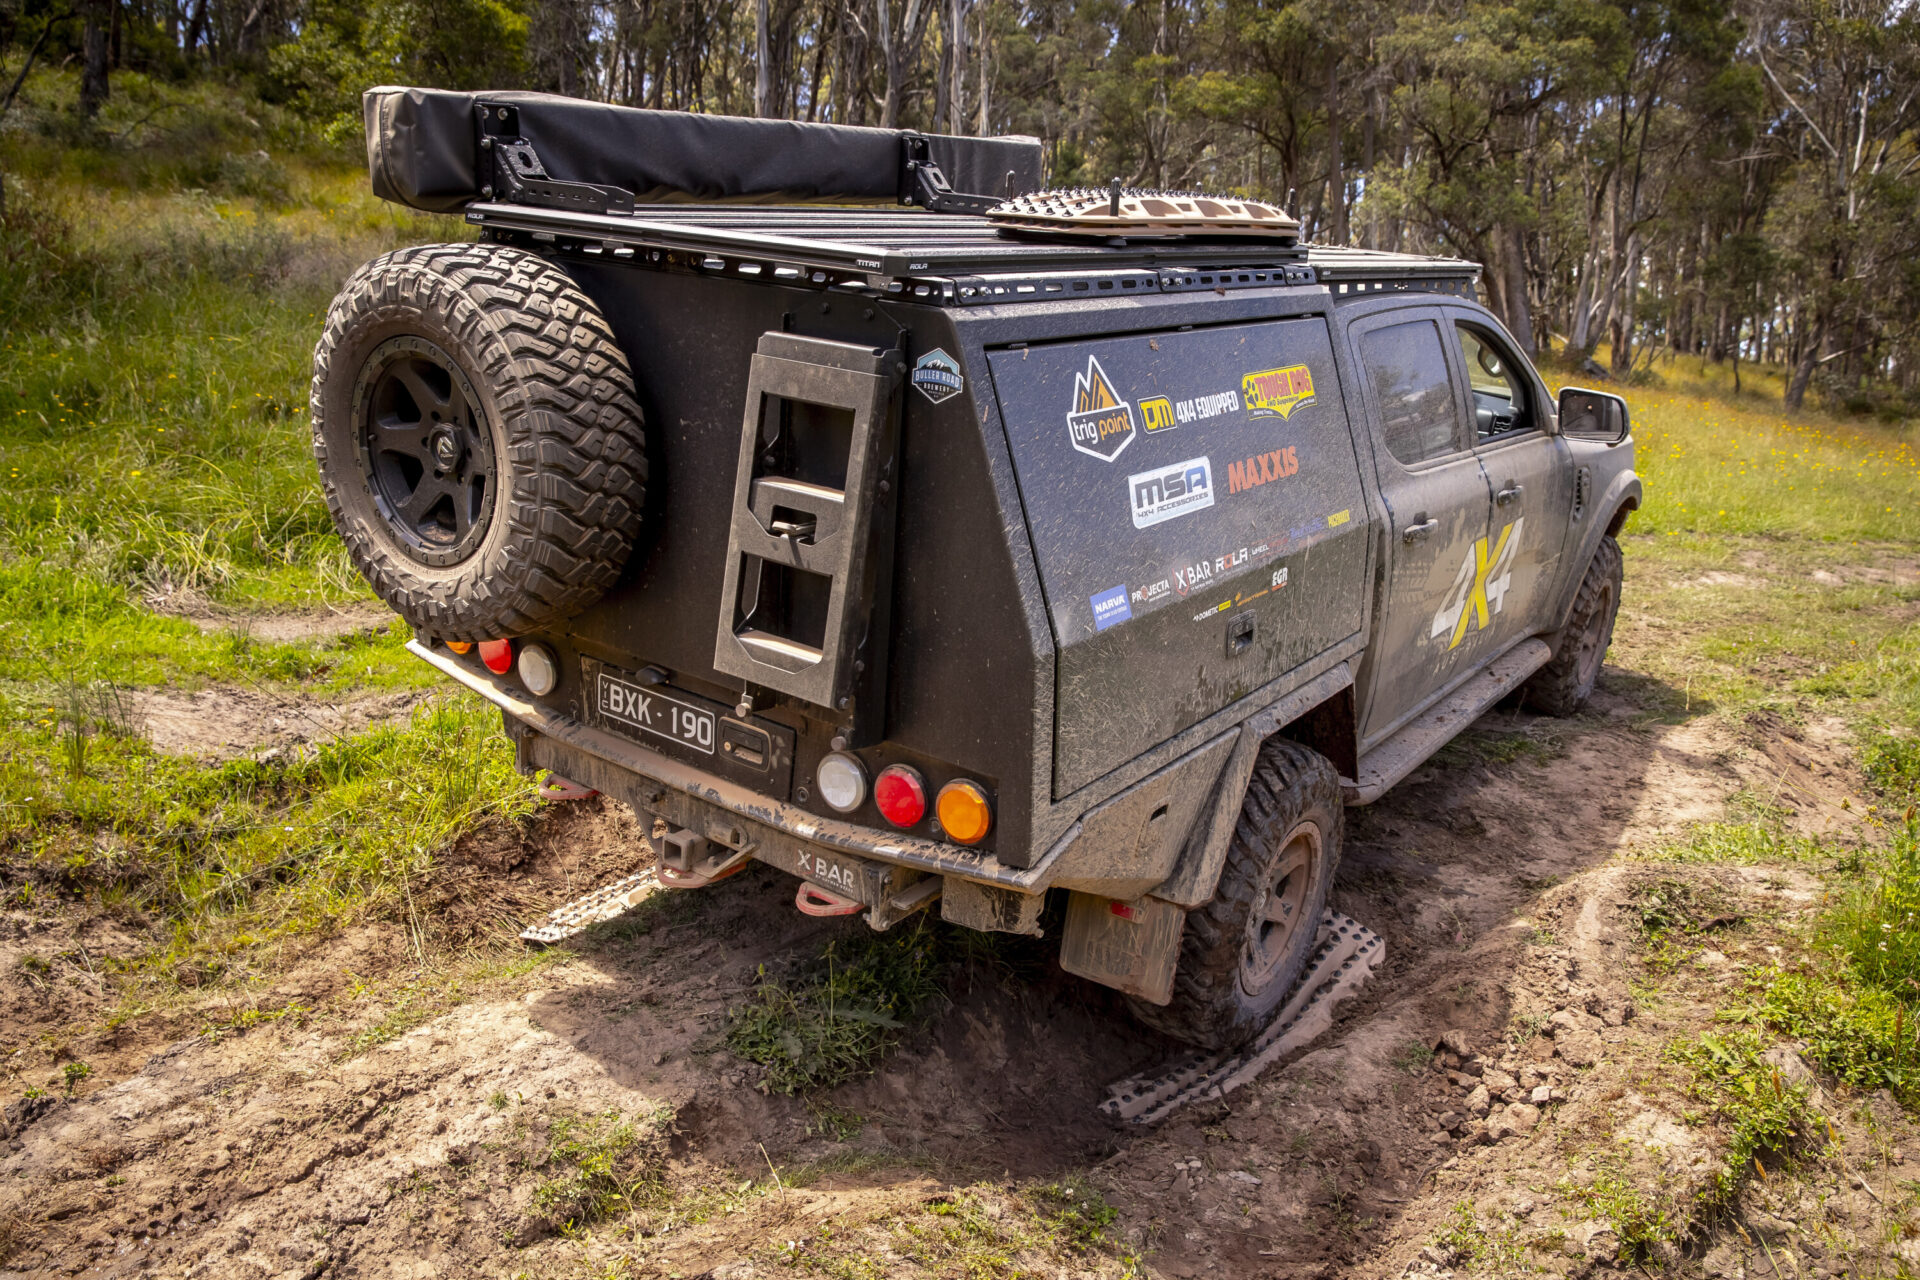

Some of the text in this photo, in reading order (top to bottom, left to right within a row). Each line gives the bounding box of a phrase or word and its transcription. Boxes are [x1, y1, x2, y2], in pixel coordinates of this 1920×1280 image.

[856, 259, 880, 268] TITAN
[915, 370, 960, 388] BULLER ROAD
[923, 382, 950, 392] BREWERY
[1253, 367, 1312, 401] TOUGH DOG
[1175, 399, 1198, 423] 4X4
[1195, 390, 1240, 420] EQUIPPED
[1072, 411, 1131, 444] trig point
[1228, 445, 1299, 494] MAXXIS
[1134, 465, 1208, 509] MSA
[1156, 492, 1209, 513] ACCESSORIES
[1186, 561, 1212, 584] BAR
[1215, 547, 1249, 573] ROLA
[1272, 566, 1289, 587] EGR
[1131, 579, 1170, 603] PROJECTA
[1094, 594, 1126, 614] NARVA
[609, 683, 712, 746] BXK 190
[815, 857, 854, 889] BAR
